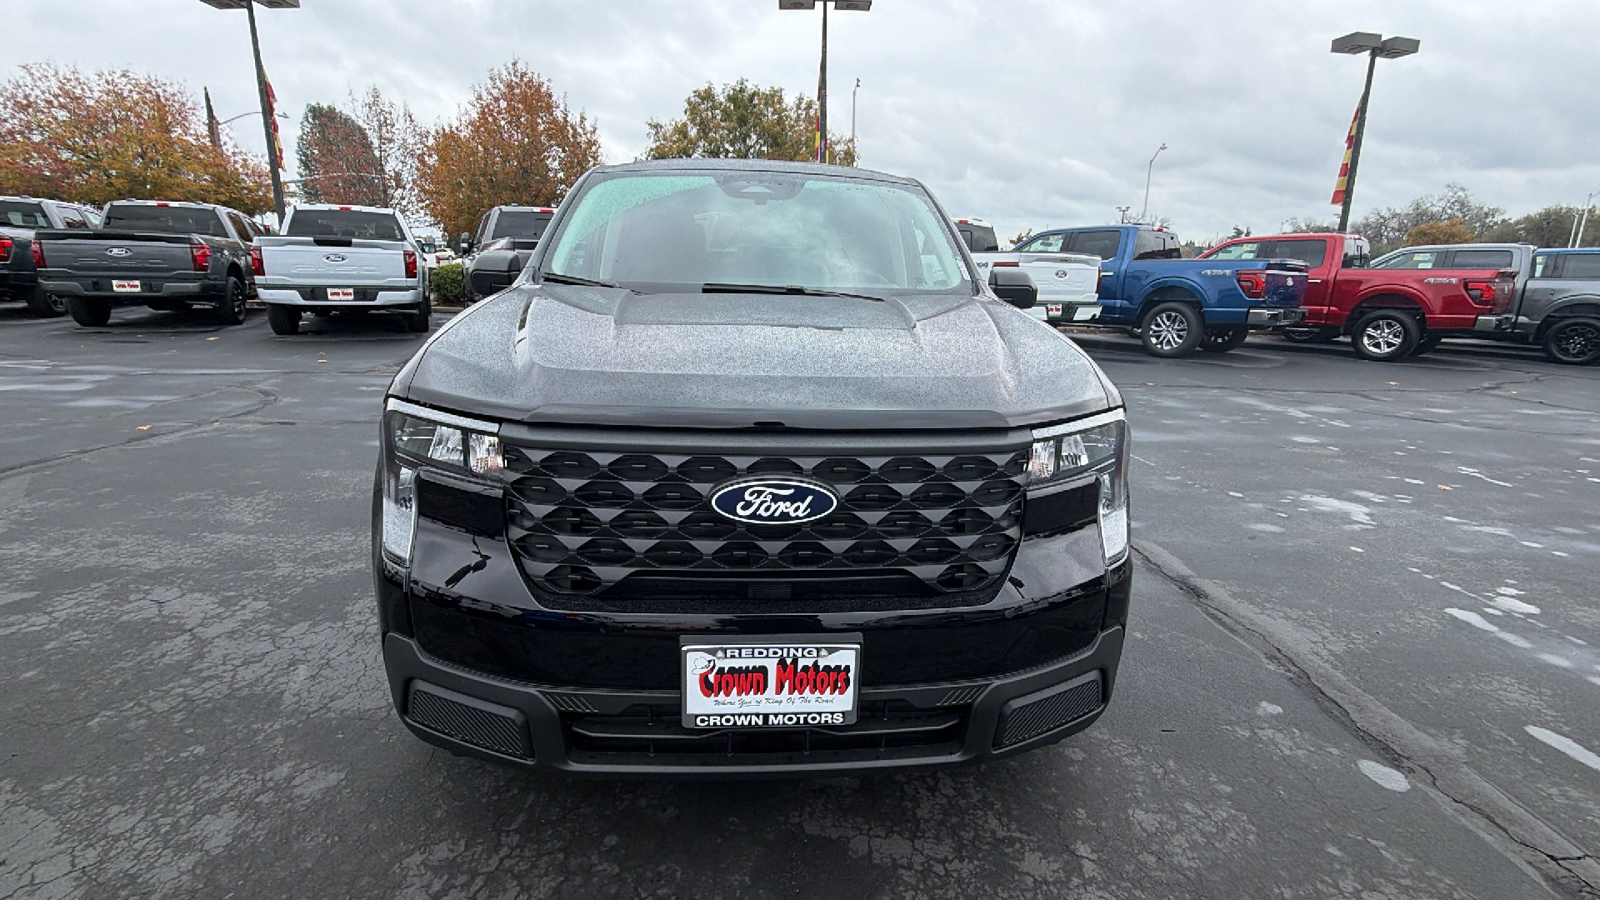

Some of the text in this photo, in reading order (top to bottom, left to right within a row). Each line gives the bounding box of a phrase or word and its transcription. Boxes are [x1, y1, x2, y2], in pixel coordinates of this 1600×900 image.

[736, 486, 814, 517] Ford
[726, 648, 818, 658] REDDING
[698, 657, 851, 698] Crown Motors
[765, 697, 783, 706] King
[786, 696, 796, 705] Of
[798, 696, 811, 705] The
[814, 697, 835, 705] Road
[696, 713, 844, 727] CROWN MOTORS
